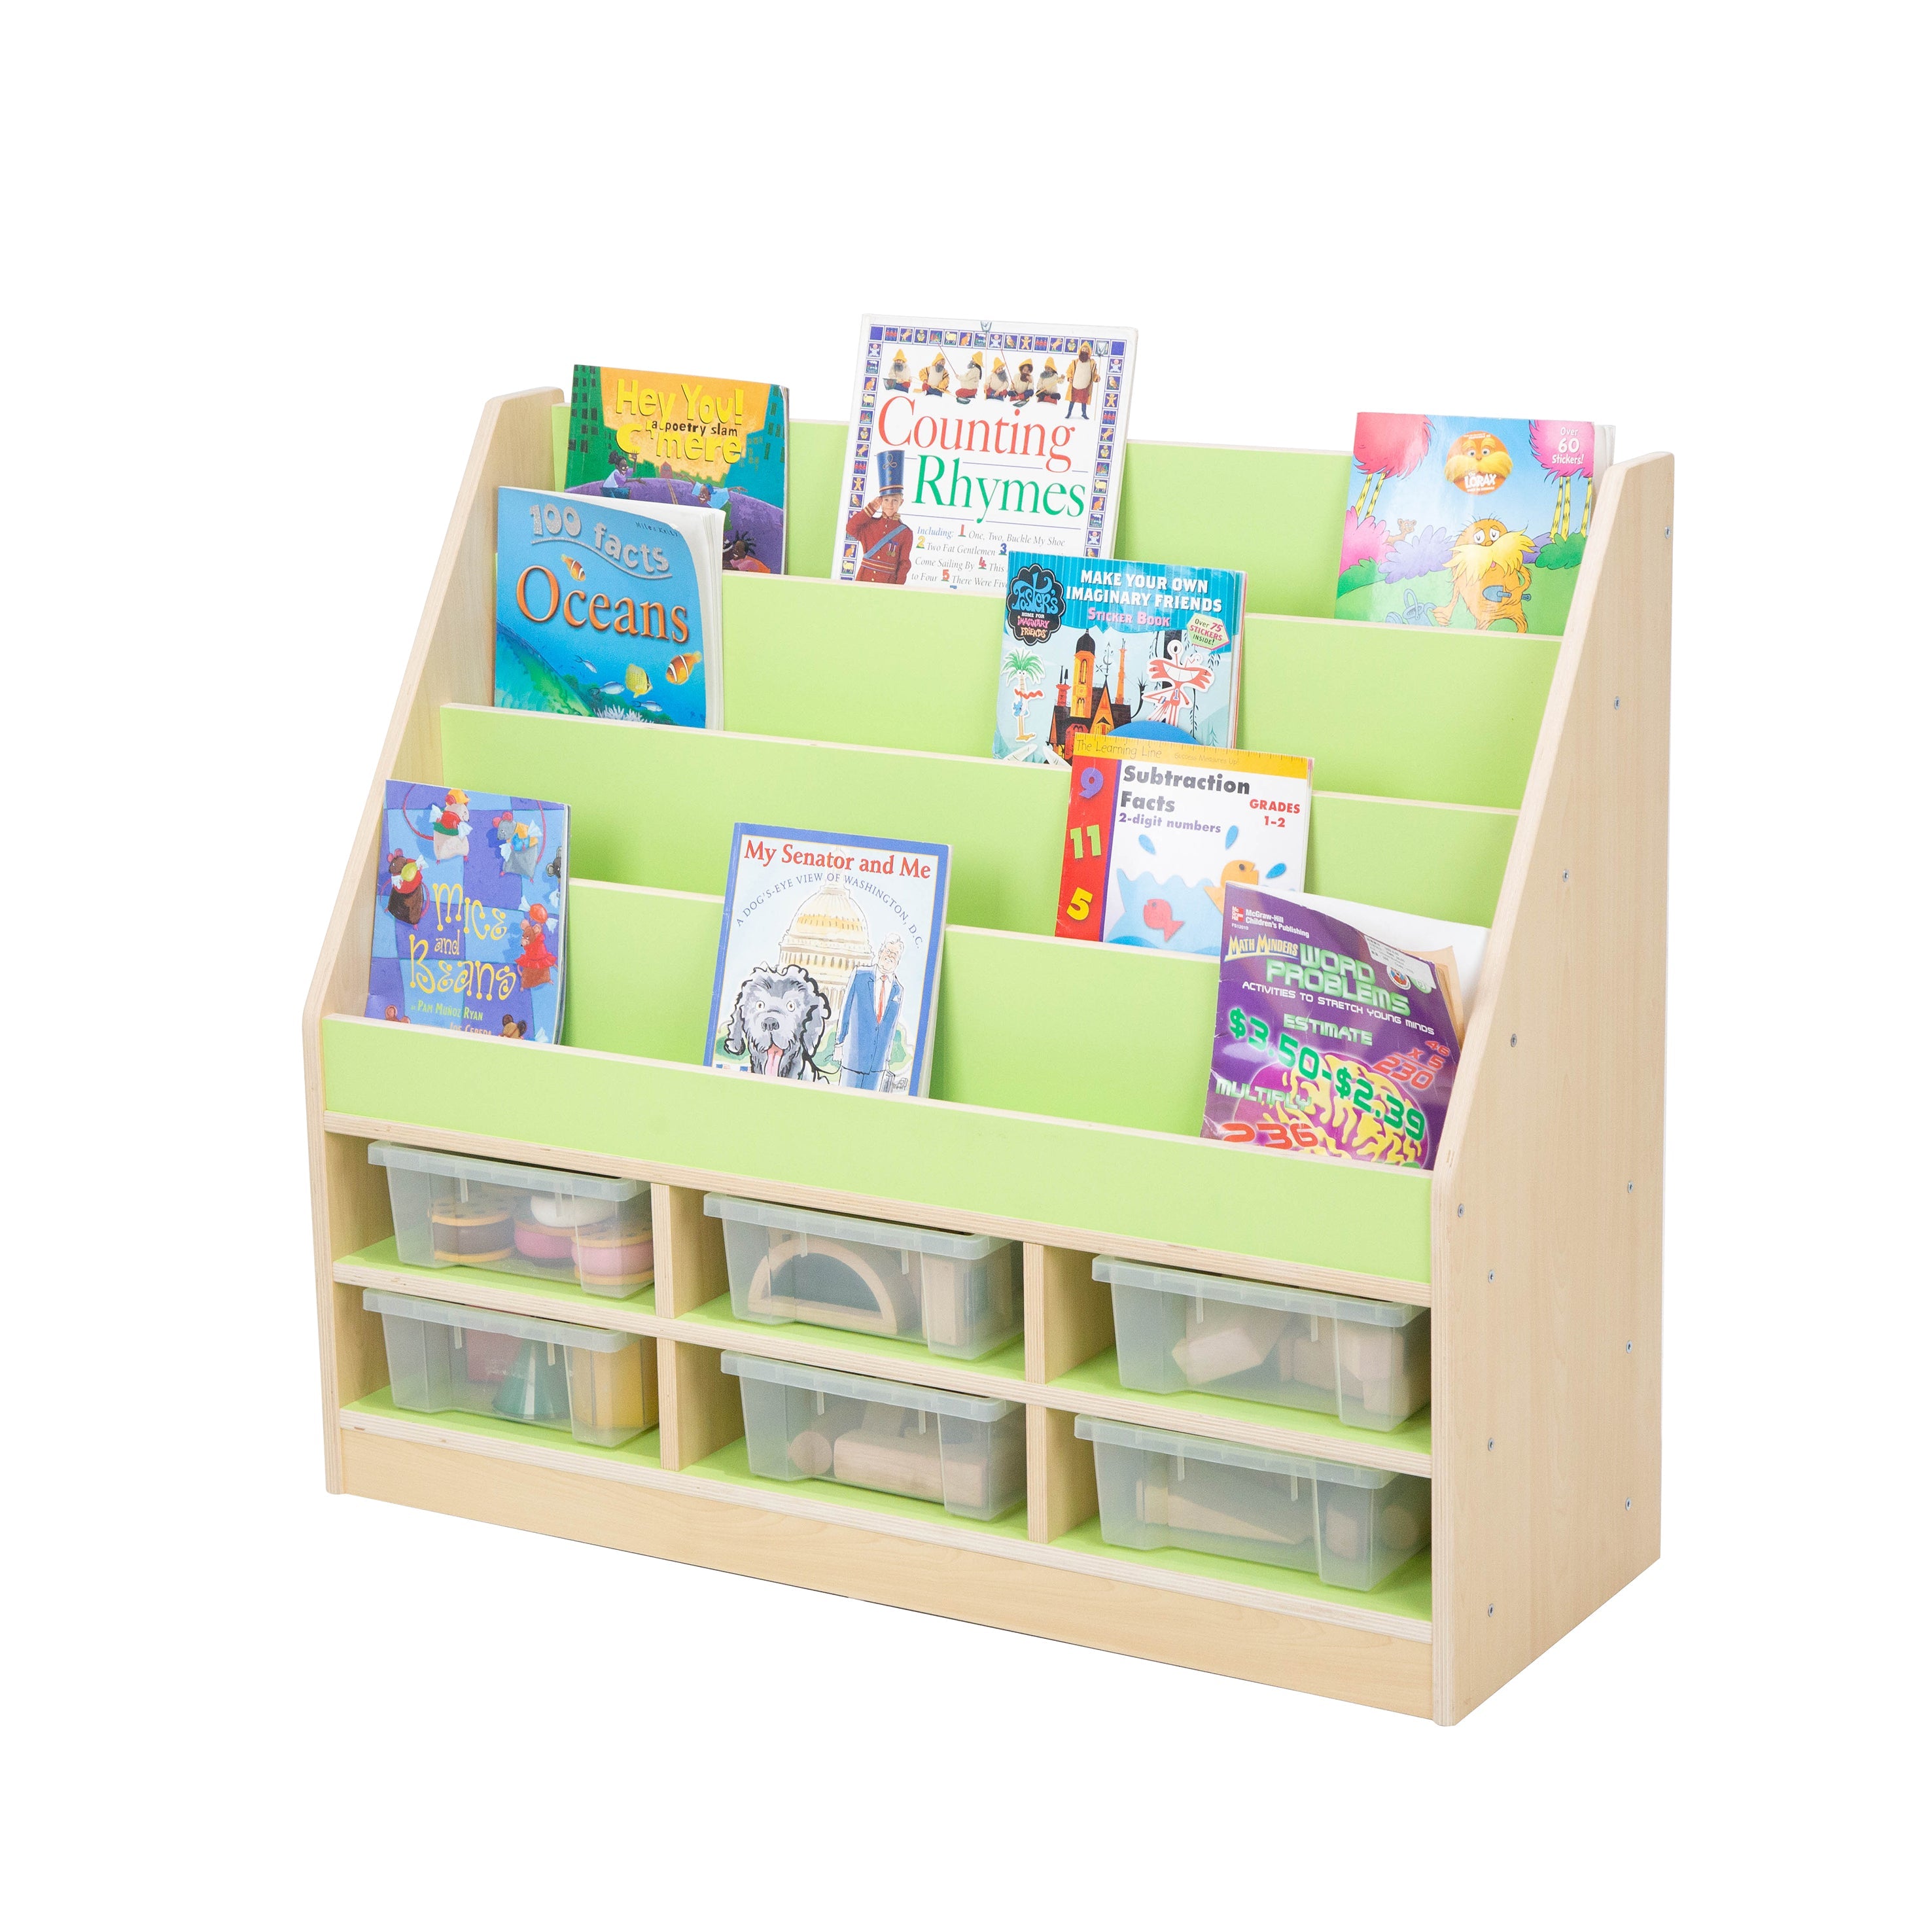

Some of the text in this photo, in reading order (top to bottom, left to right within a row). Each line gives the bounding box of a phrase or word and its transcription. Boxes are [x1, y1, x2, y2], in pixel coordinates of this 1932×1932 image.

[616, 379, 744, 429] Hey You!
[651, 420, 737, 437] a poetry slam
[879, 396, 1075, 473] Counting
[1560, 427, 1579, 436] Over
[1558, 437, 1580, 453] 60
[1551, 453, 1585, 465] Stickers!
[911, 455, 1085, 523] Rhymes
[1465, 473, 1496, 488] LORAX
[529, 503, 669, 573] 100 facts
[916, 536, 1008, 556] 2 Two Fat Gentlemen 3
[917, 524, 1065, 547] Including: 1 One, Two, Buckle My Shoe
[915, 557, 1004, 572] Come Sailing By 4 This
[920, 572, 938, 582] Four
[941, 569, 950, 582] 5
[952, 575, 973, 586] There
[974, 578, 992, 587] Were
[1081, 570, 1208, 593] MAKE YOUR OWN
[516, 565, 689, 643] Oceans
[1066, 586, 1222, 612] IMAGINARY FRIENDS
[1189, 625, 1222, 641] STICKERS
[1195, 618, 1223, 632] Over 75
[1193, 634, 1214, 645] INSIDE!
[1076, 739, 1162, 760] The Learning Line
[1079, 767, 1104, 799] 9
[1123, 765, 1250, 794] Subtraction
[1120, 791, 1175, 813] Facts
[1249, 799, 1300, 814] GRADES
[1119, 813, 1221, 833] 2-digit numbers
[1264, 815, 1285, 828] 1-2
[1070, 824, 1102, 859] 11
[745, 840, 931, 879] My Senator and Me
[432, 883, 506, 940] Mice
[736, 873, 923, 949] A DOG'S-EYE VIEW OF WASHINGTON, D.C.
[1066, 887, 1093, 921] 5
[1246, 909, 1284, 923] McGraw-Hill
[1246, 917, 1309, 938] Children's Publishing
[434, 930, 460, 955] and
[409, 934, 516, 1000] Beans
[1299, 943, 1375, 983] WORD
[1267, 959, 1411, 1016] PROBLEMS
[464, 1007, 483, 1021] RYAN
[1242, 981, 1434, 1034] ACTIVITIES TO STRETCH YOUNG MINDS
[1284, 1013, 1373, 1046] ESTIMATE
[1425, 1040, 1450, 1056] 46
[1373, 1056, 1433, 1089] 230
[1429, 1056, 1444, 1070] 5
[1216, 1078, 1312, 1112] MULTIPLY
